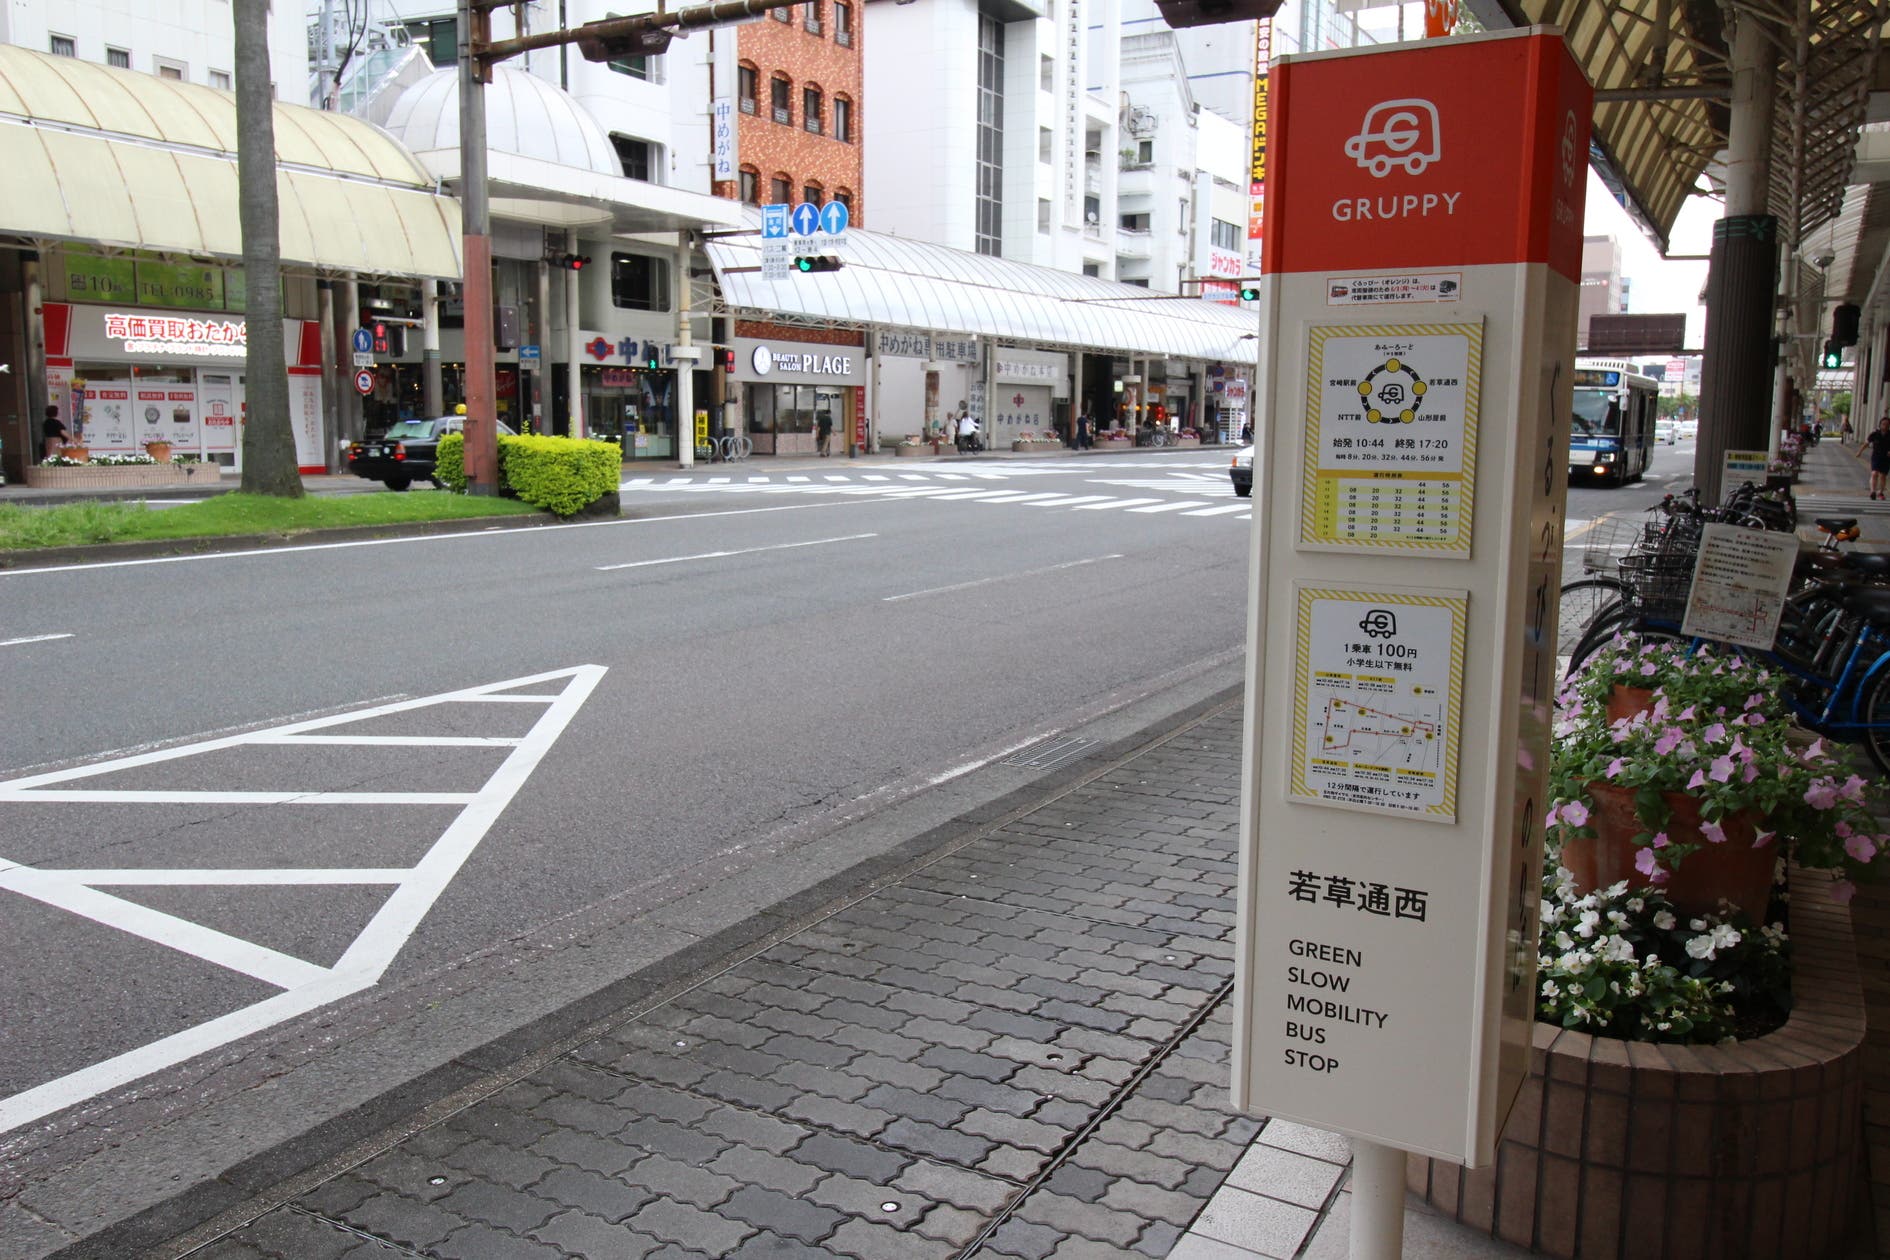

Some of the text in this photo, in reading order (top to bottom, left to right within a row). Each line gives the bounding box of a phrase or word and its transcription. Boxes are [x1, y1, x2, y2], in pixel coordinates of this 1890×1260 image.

[717, 103, 730, 173] 中めがね
[1332, 193, 1461, 221] GRUPPY
[1211, 252, 1241, 277] ジャンカラ
[773, 353, 798, 362] BEAUTY
[779, 362, 801, 371] SALON
[803, 354, 851, 374] PLAGE
[1333, 438, 1448, 449] 始発 10:44 終発 17:20
[1344, 643, 1417, 658] 1乗車 100円
[1346, 658, 1412, 672] 小学生以下無料
[1327, 782, 1420, 800] 12分間隔で運行しています
[1288, 870, 1428, 922] 若草通西
[1289, 939, 1362, 967] GREEN
[1288, 967, 1350, 992] SLOW
[1287, 994, 1388, 1028] MOBILITY
[1286, 1021, 1326, 1044] BUS
[1284, 1049, 1339, 1074] STOP
